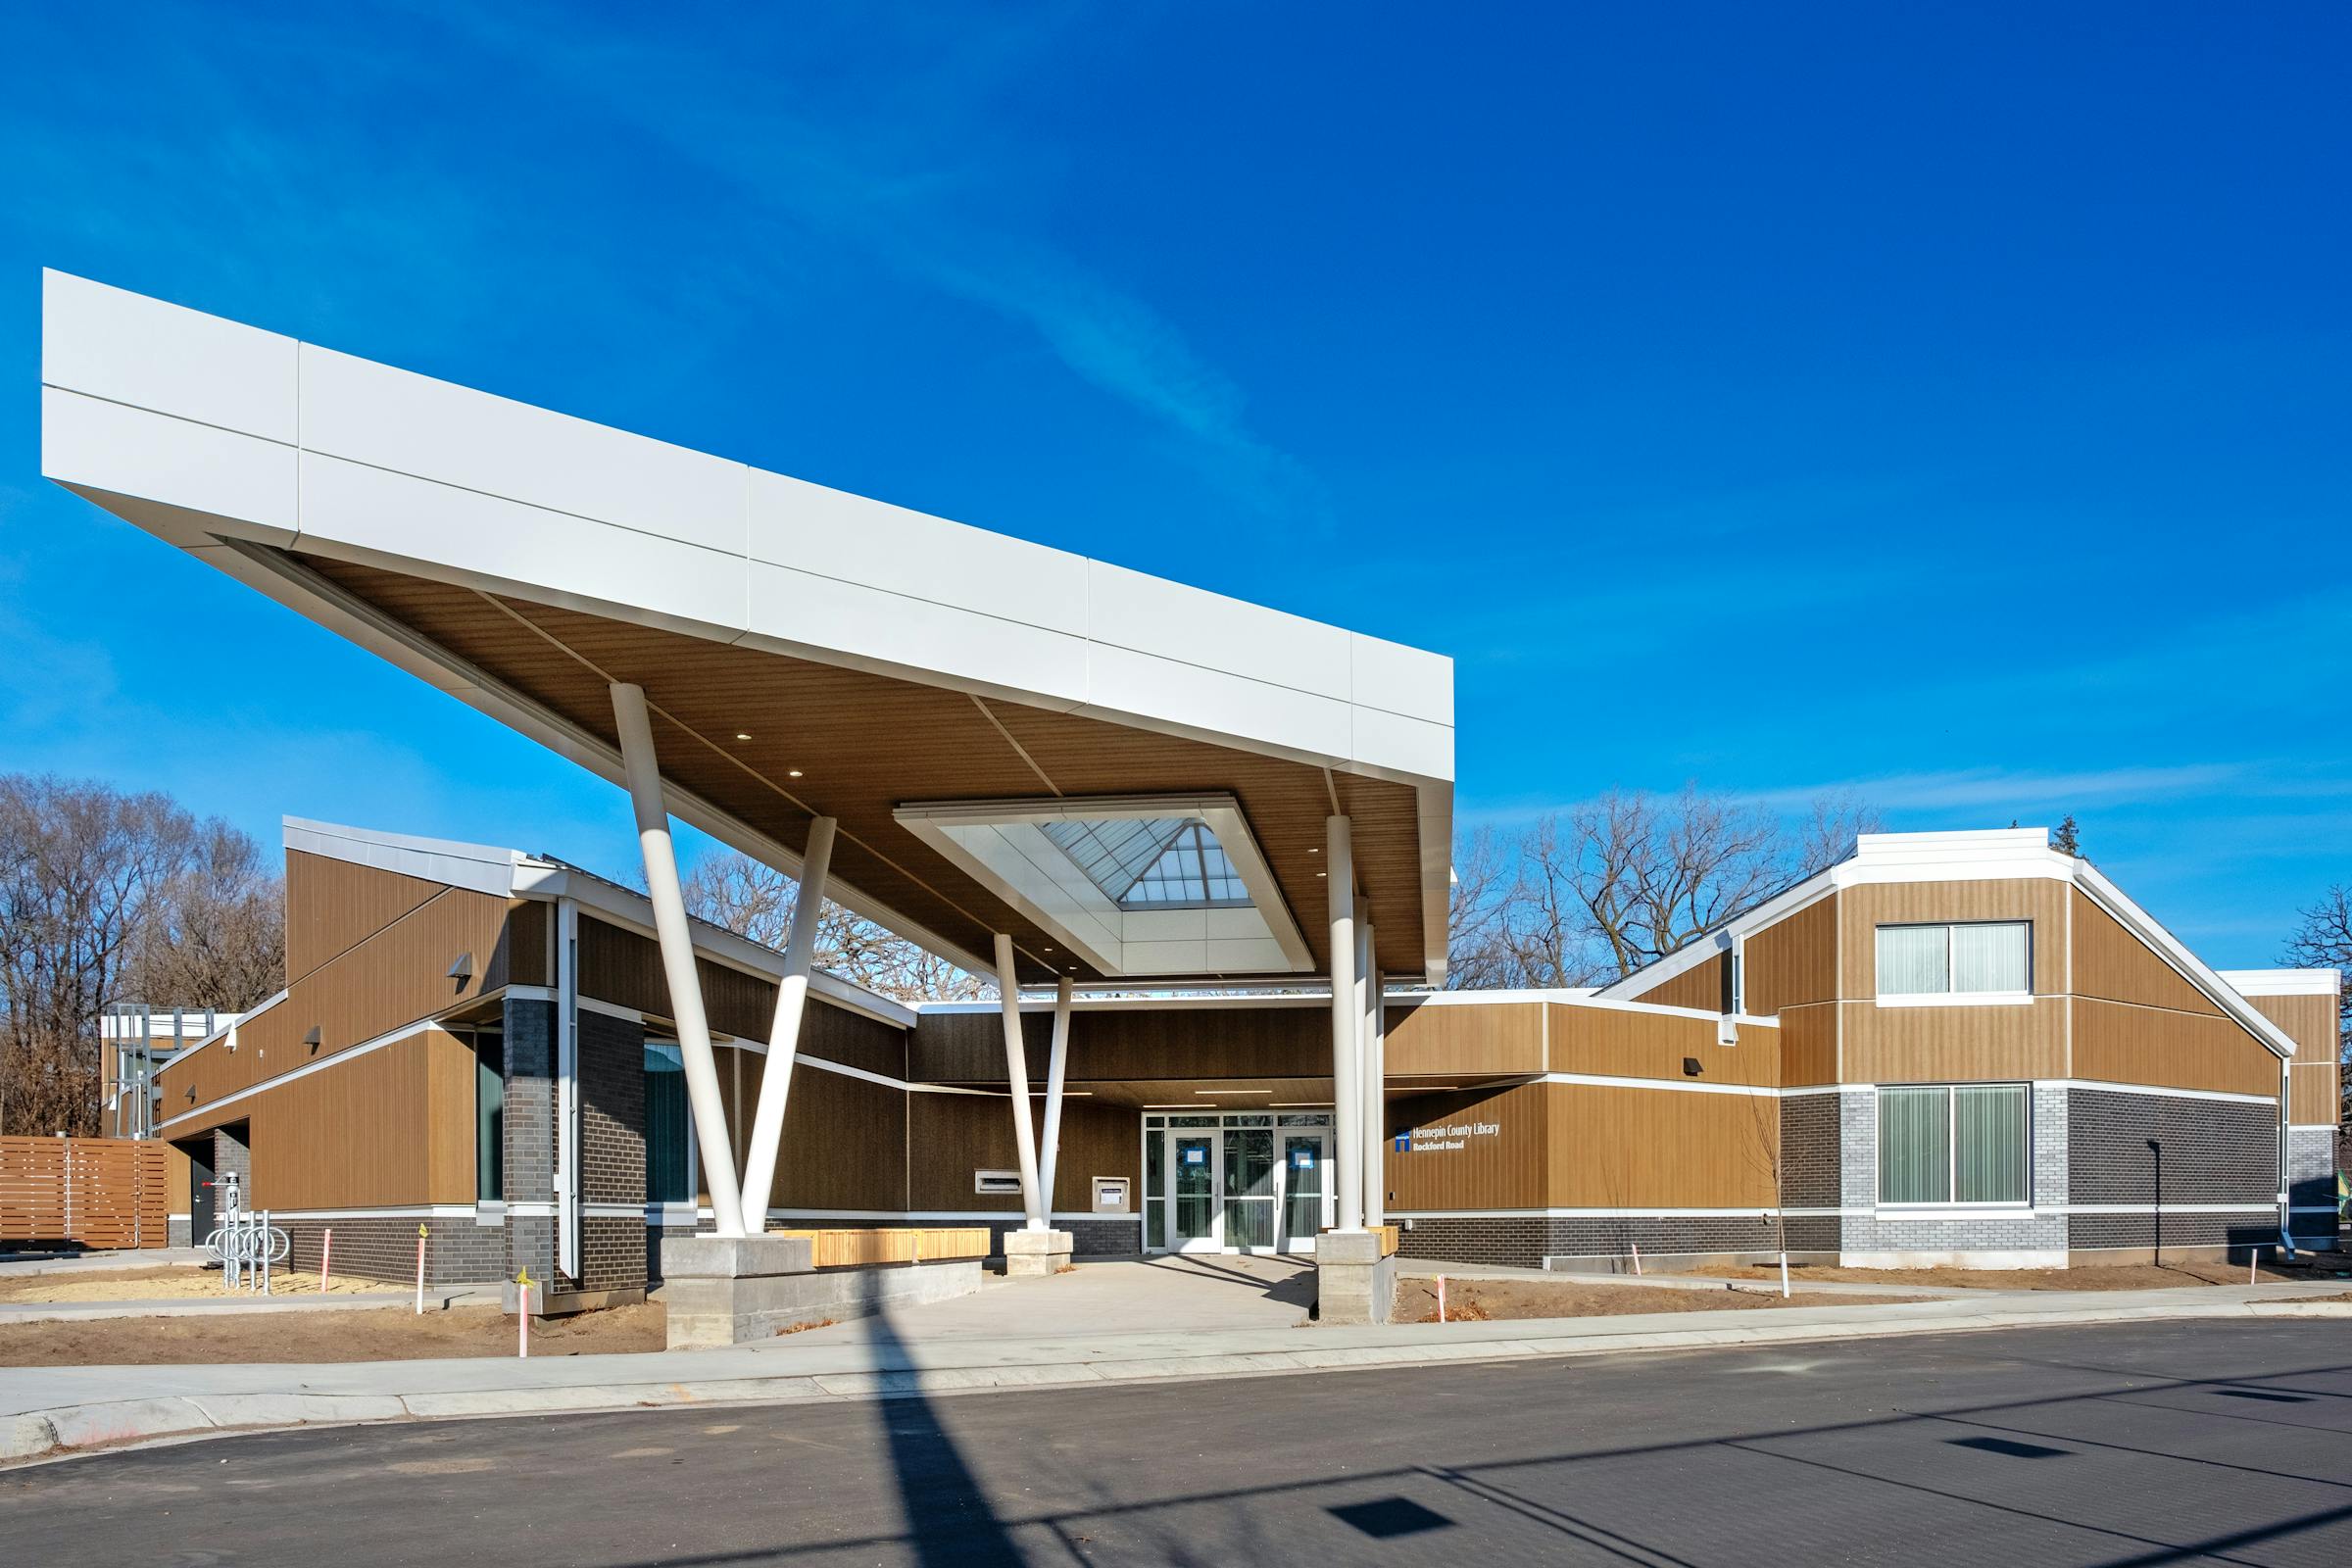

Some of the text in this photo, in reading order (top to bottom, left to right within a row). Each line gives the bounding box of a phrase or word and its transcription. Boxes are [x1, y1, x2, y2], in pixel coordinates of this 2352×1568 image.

[1413, 1122, 1499, 1140] Hennepin County Library
[1413, 1140, 1464, 1152] Rockford Road
